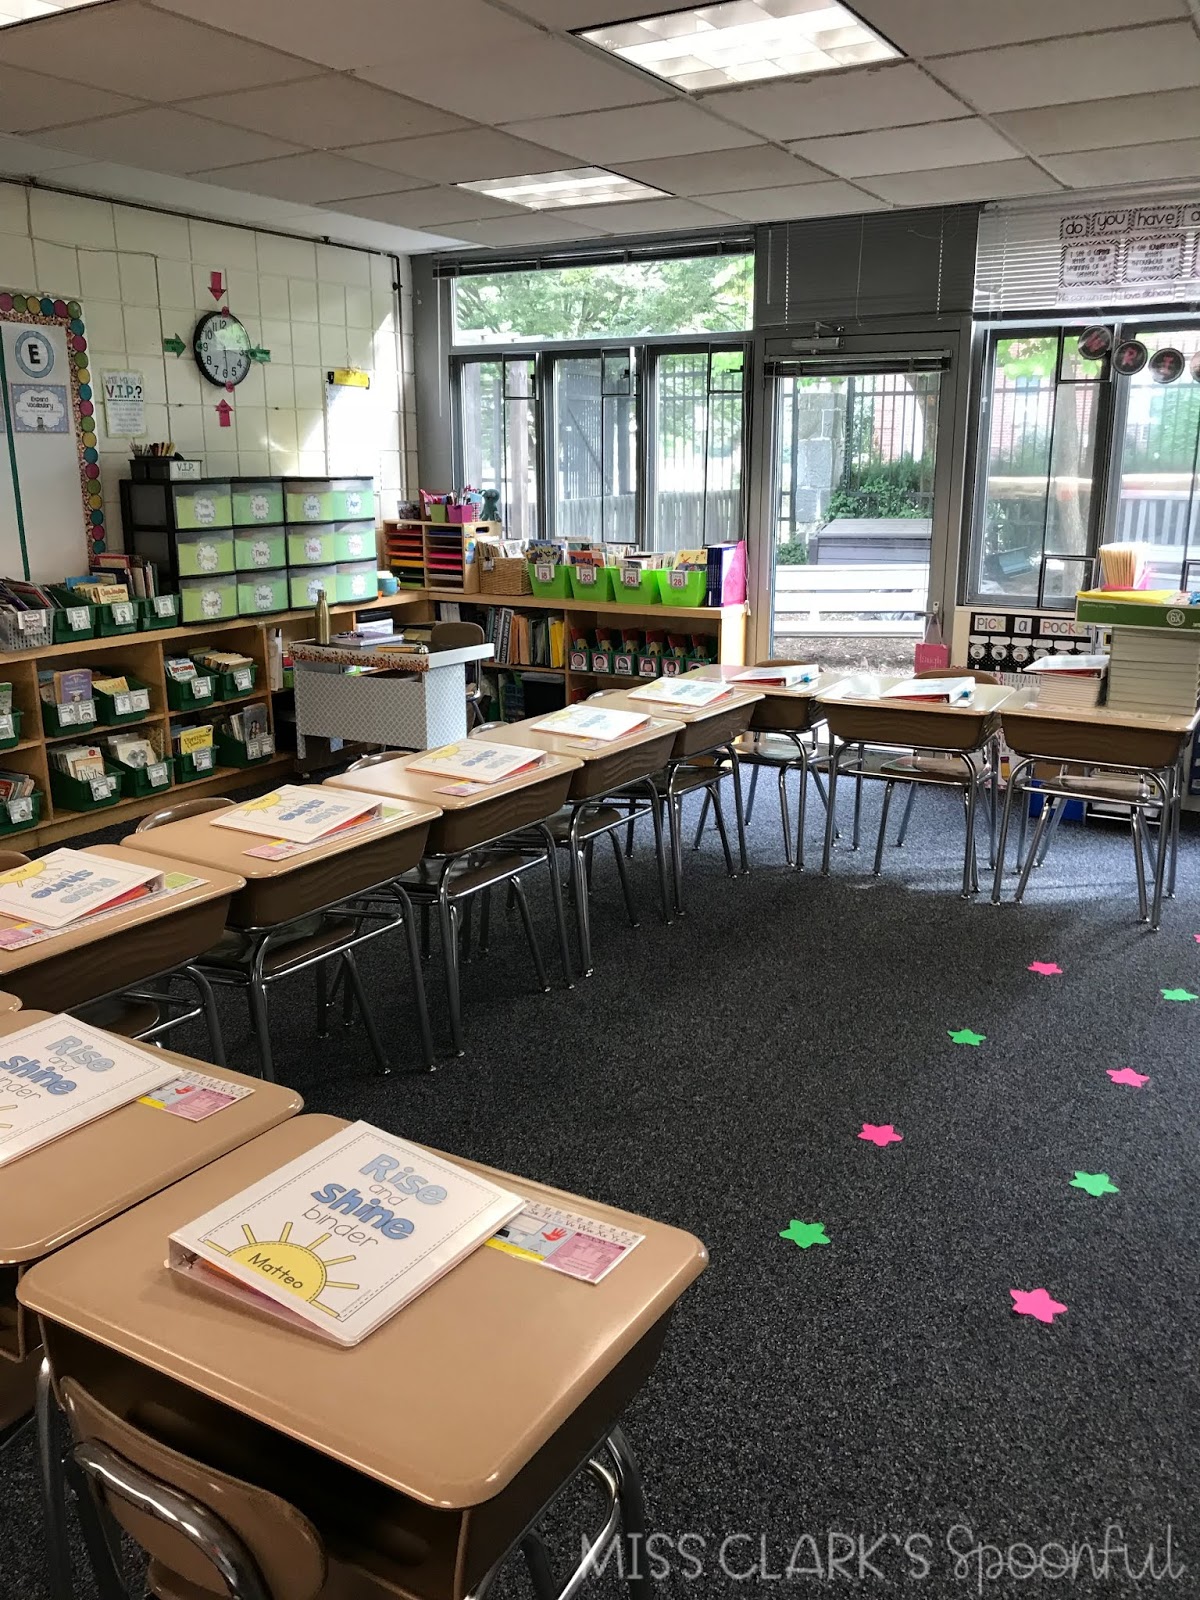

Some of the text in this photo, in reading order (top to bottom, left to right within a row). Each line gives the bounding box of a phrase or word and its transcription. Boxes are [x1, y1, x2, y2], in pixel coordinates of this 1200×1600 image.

[1065, 221, 1083, 235] do
[1097, 213, 1126, 231] you
[1137, 212, 1175, 227] have
[212, 322, 218, 332] 11
[219, 320, 227, 330] 12
[205, 330, 213, 340] 10
[202, 342, 209, 352] 9
[238, 347, 245, 357] 3
[27, 343, 42, 365] E
[206, 355, 213, 366] 8
[237, 359, 243, 369] 4
[214, 365, 220, 375] 7
[222, 368, 229, 379] 6
[231, 367, 237, 377] 5
[105, 384, 143, 399] V.I.P.?
[176, 462, 195, 472] V.I.P.
[582, 573, 592, 582] 20
[626, 576, 636, 584] 24
[673, 578, 682, 587] 28
[1170, 612, 1181, 623] 6X
[1018, 620, 1028, 632] a
[31, 869, 94, 899] shine
[59, 877, 121, 904] Rise
[45, 1034, 116, 1073] Rise
[47, 1055, 79, 1074] and
[0, 1055, 77, 1096] shine
[359, 1152, 448, 1206] Rise
[367, 1183, 406, 1207] and
[310, 1183, 416, 1240] shine
[301, 1204, 379, 1248] binder
[247, 1251, 304, 1291] Matteo
